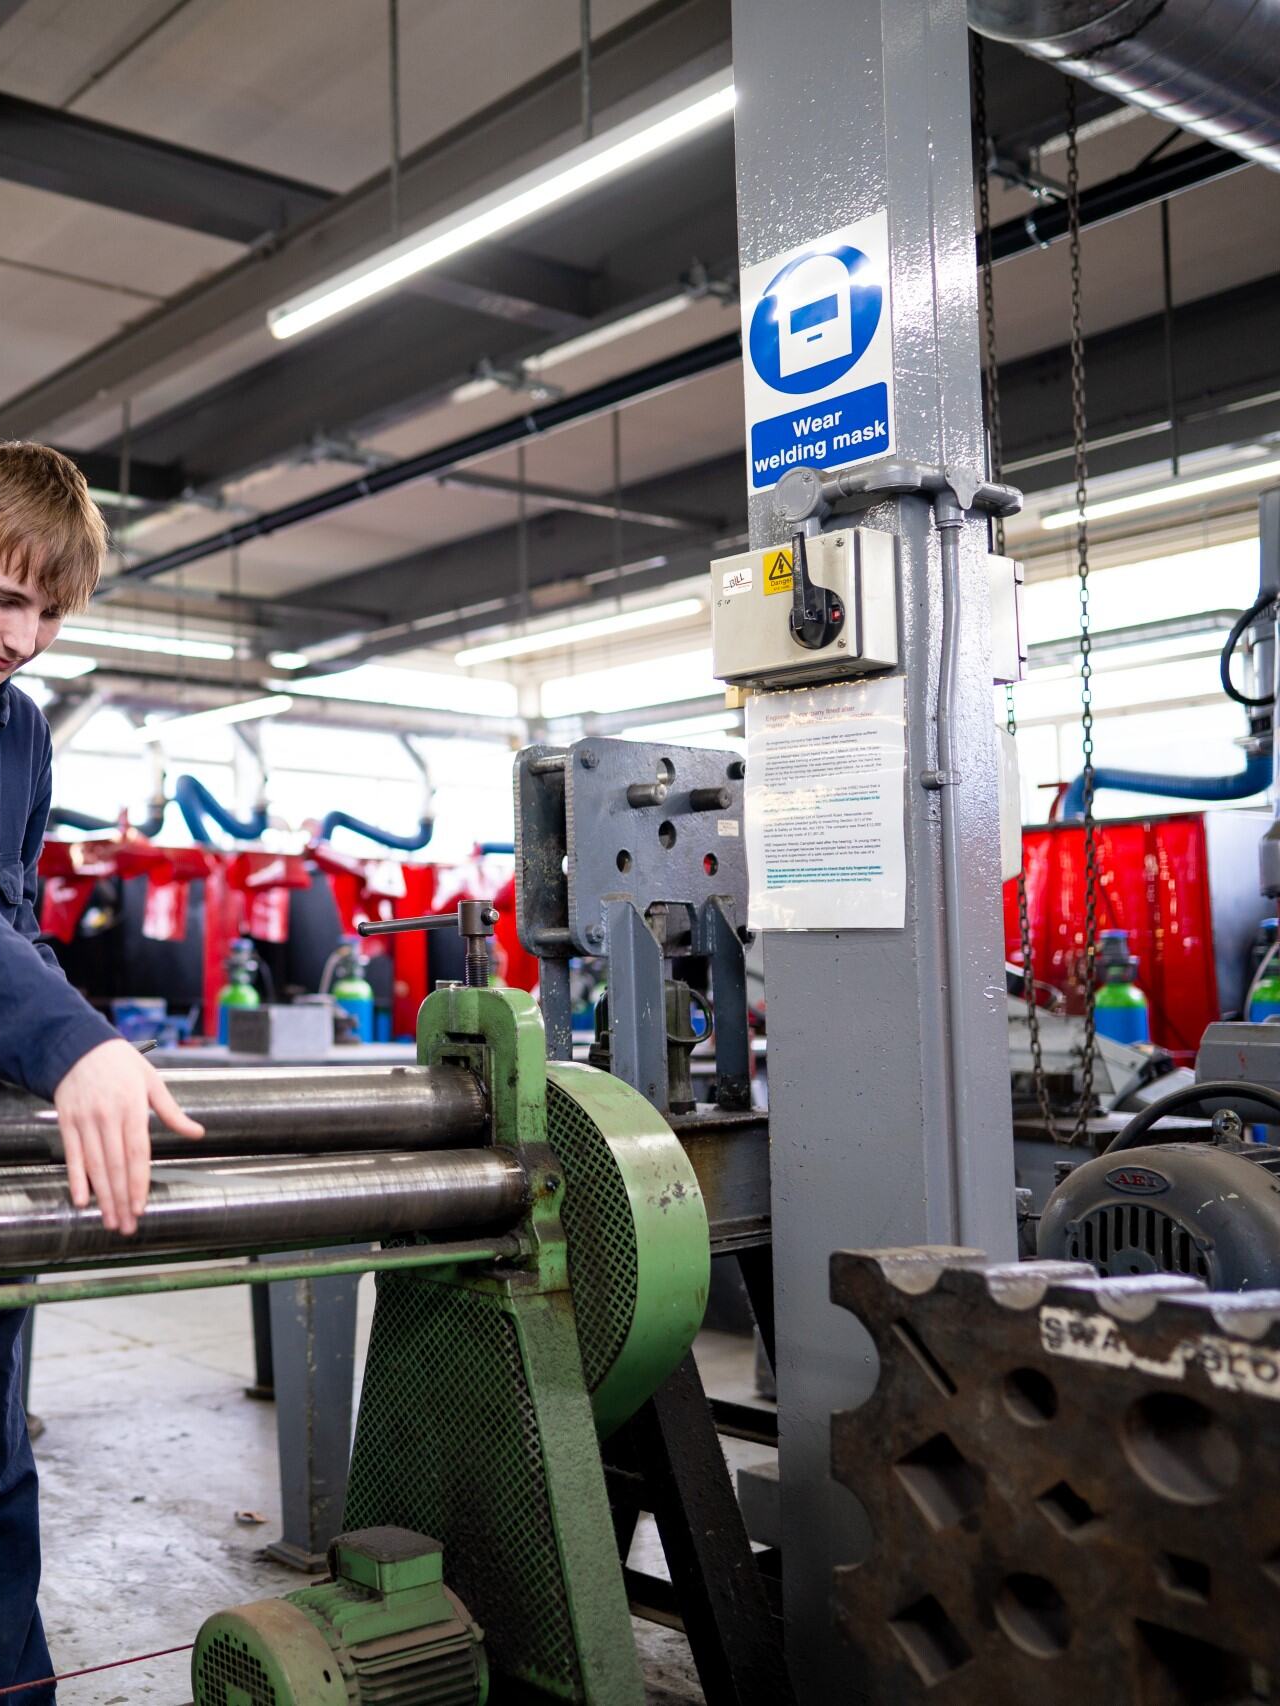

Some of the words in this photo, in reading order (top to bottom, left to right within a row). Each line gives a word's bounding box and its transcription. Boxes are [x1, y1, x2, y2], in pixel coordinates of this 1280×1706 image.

[792, 410, 843, 438] Wear
[754, 439, 827, 473] welding
[833, 419, 887, 451] mask
[1114, 1172, 1157, 1188] AEI
